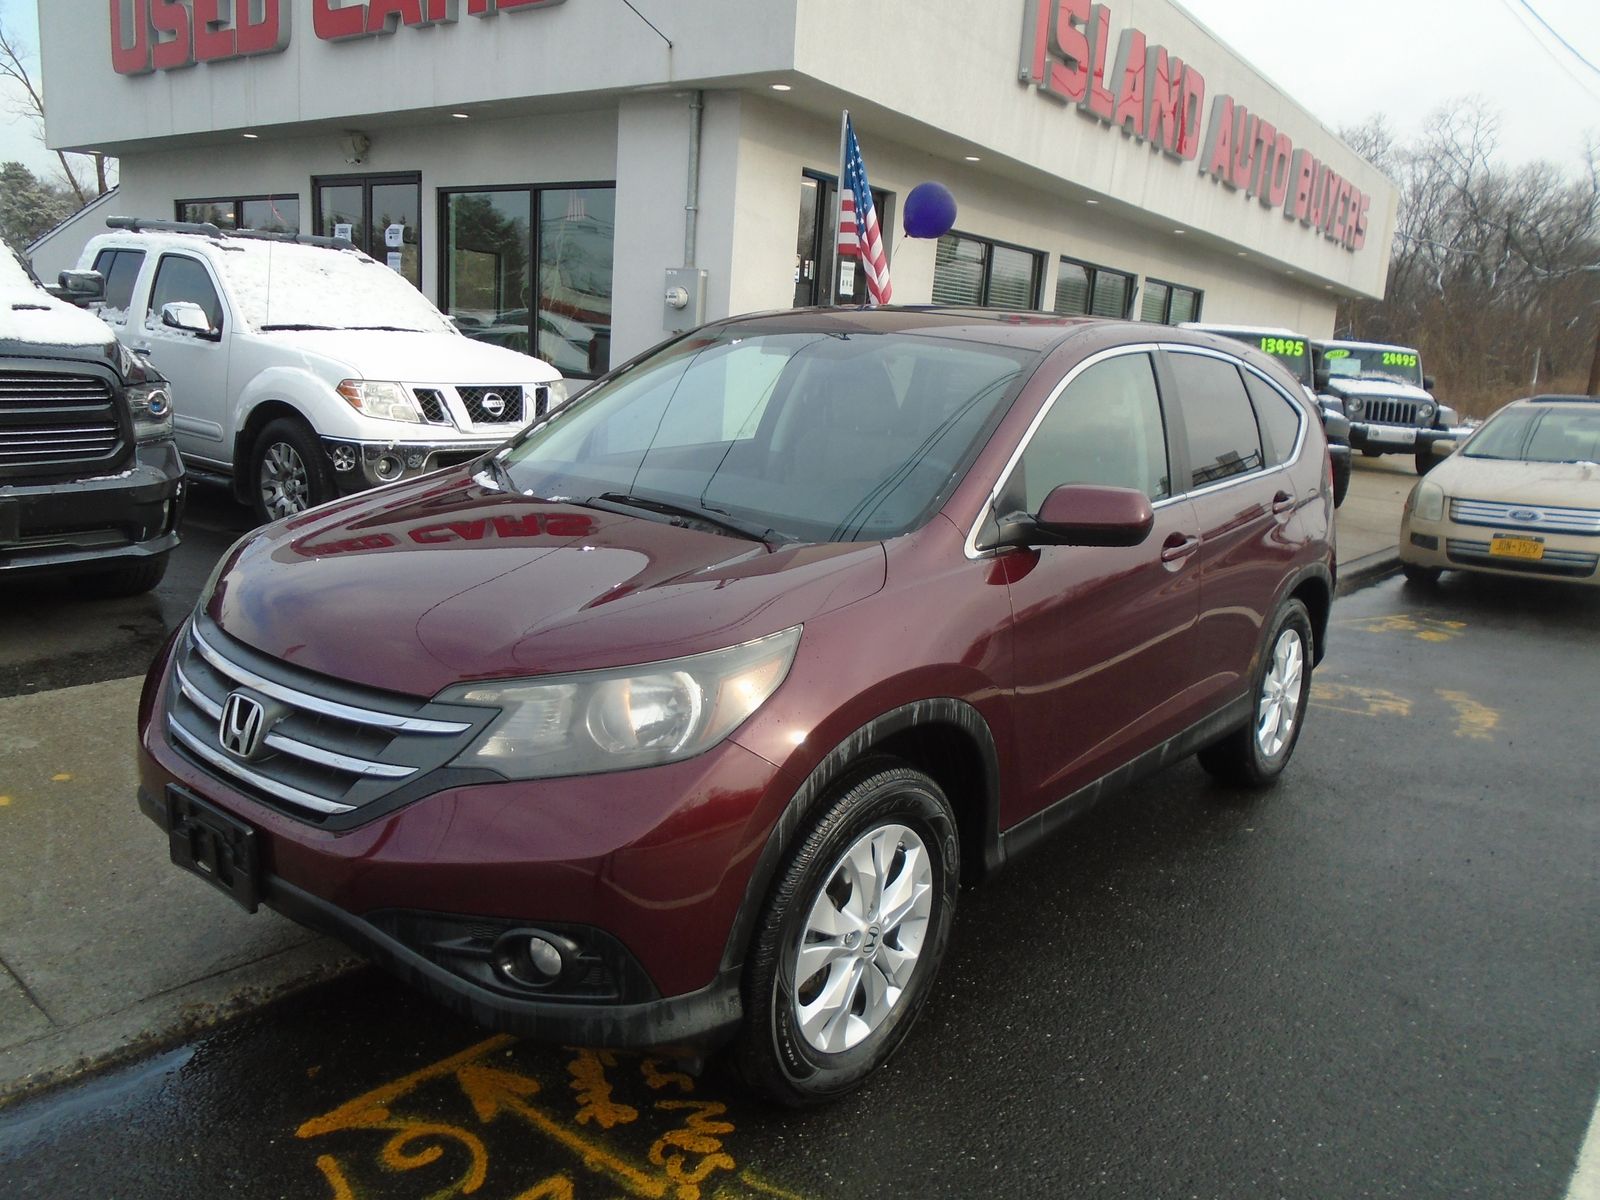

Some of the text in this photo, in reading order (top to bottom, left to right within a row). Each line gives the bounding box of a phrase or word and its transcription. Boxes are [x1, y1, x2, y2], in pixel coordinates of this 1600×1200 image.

[1020, 0, 1371, 251] ISLAND AUTO BUYERS
